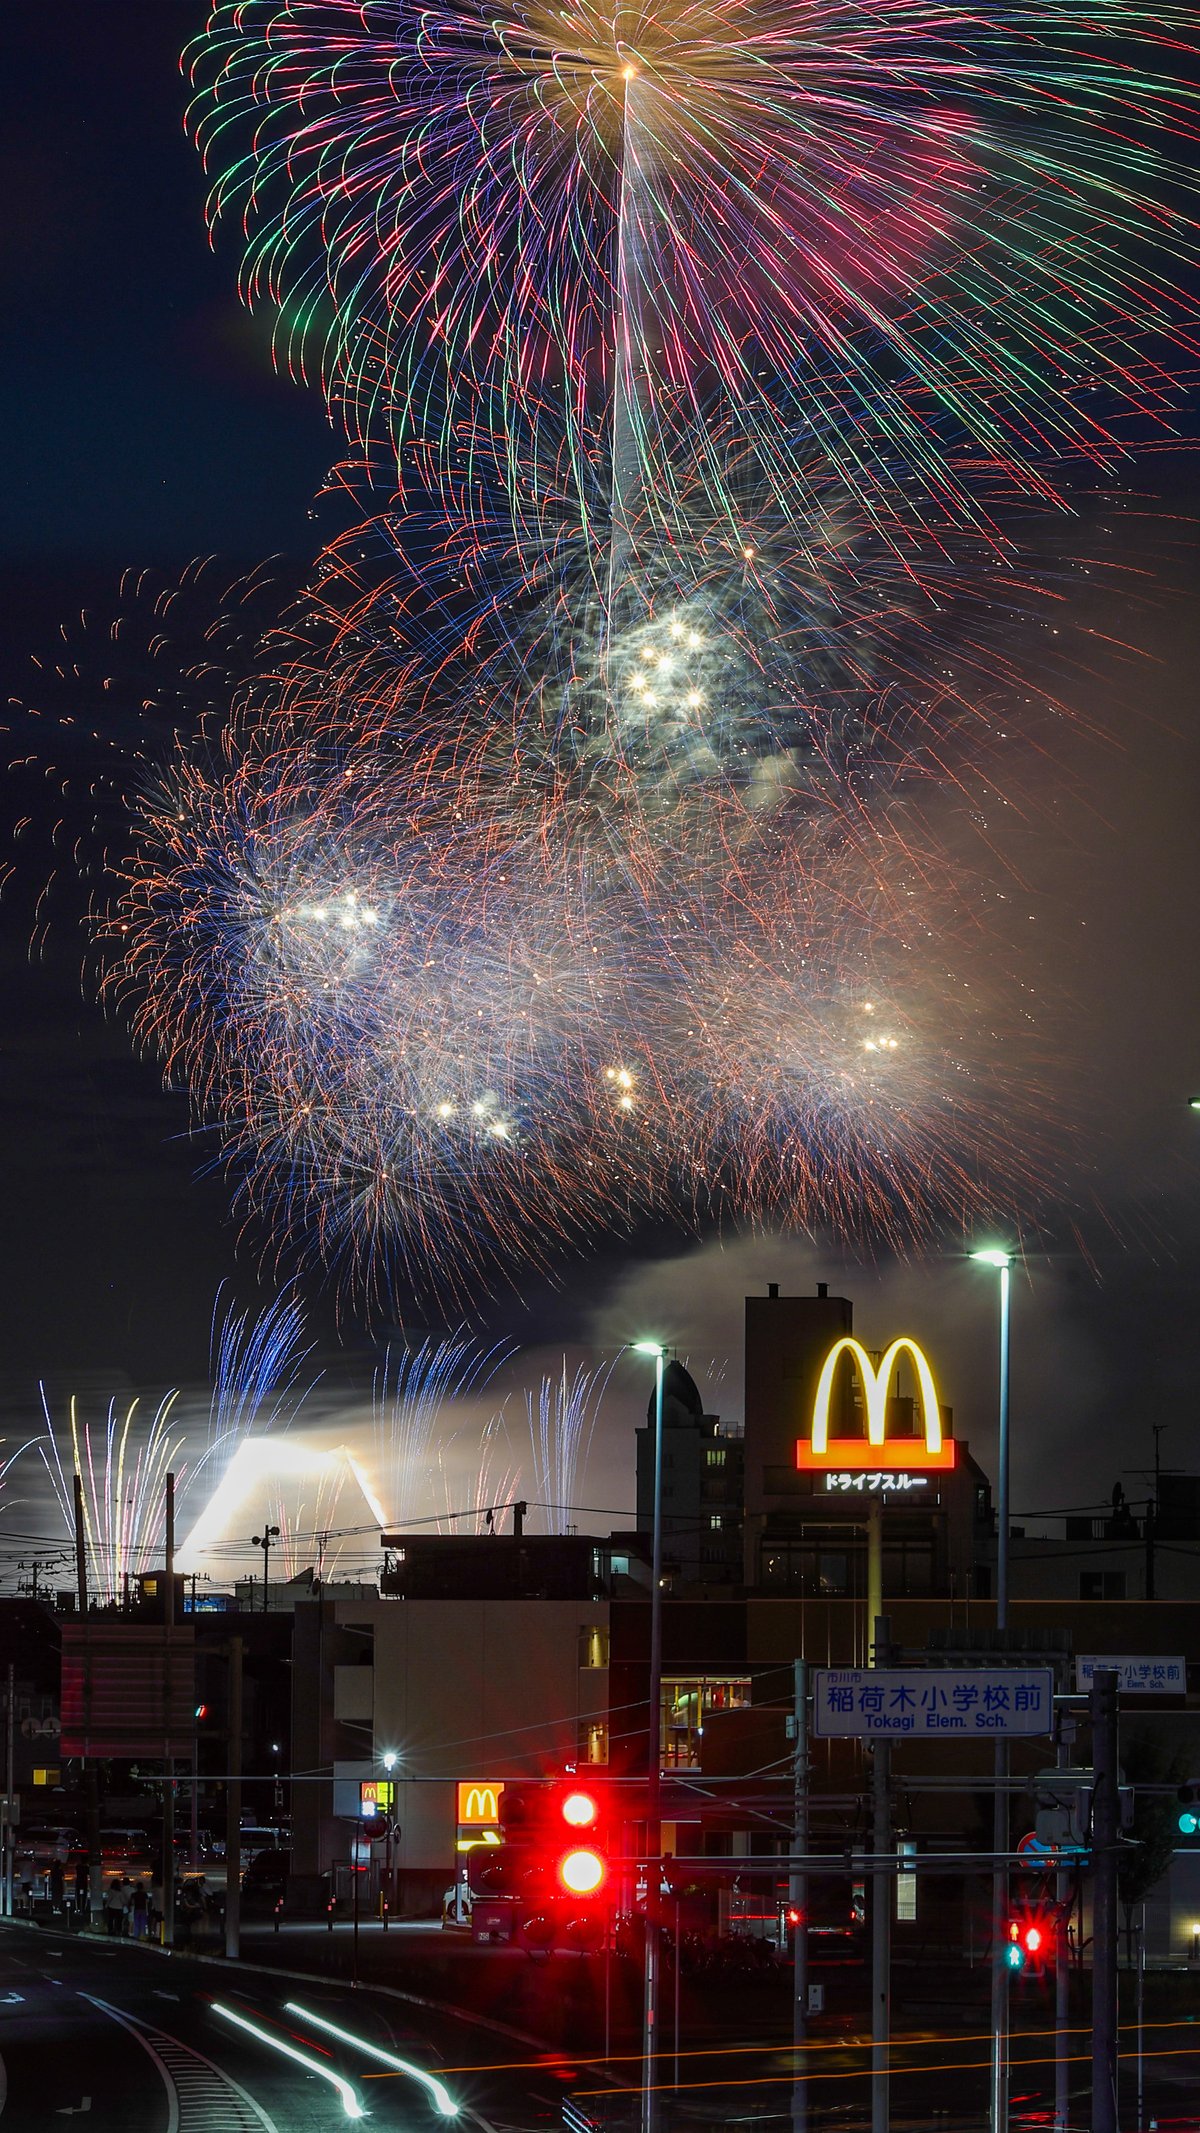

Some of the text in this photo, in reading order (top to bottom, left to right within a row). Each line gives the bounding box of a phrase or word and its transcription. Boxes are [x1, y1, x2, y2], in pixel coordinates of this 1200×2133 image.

[826, 1473, 928, 1490] ドライブスルー
[827, 1672, 862, 1683] 市川市
[1082, 1664, 1180, 1680] 稲小学校前
[827, 1684, 1042, 1712] 稲荷木小学校前
[864, 1712, 1007, 1731] Tokagi Elem. Sch.
